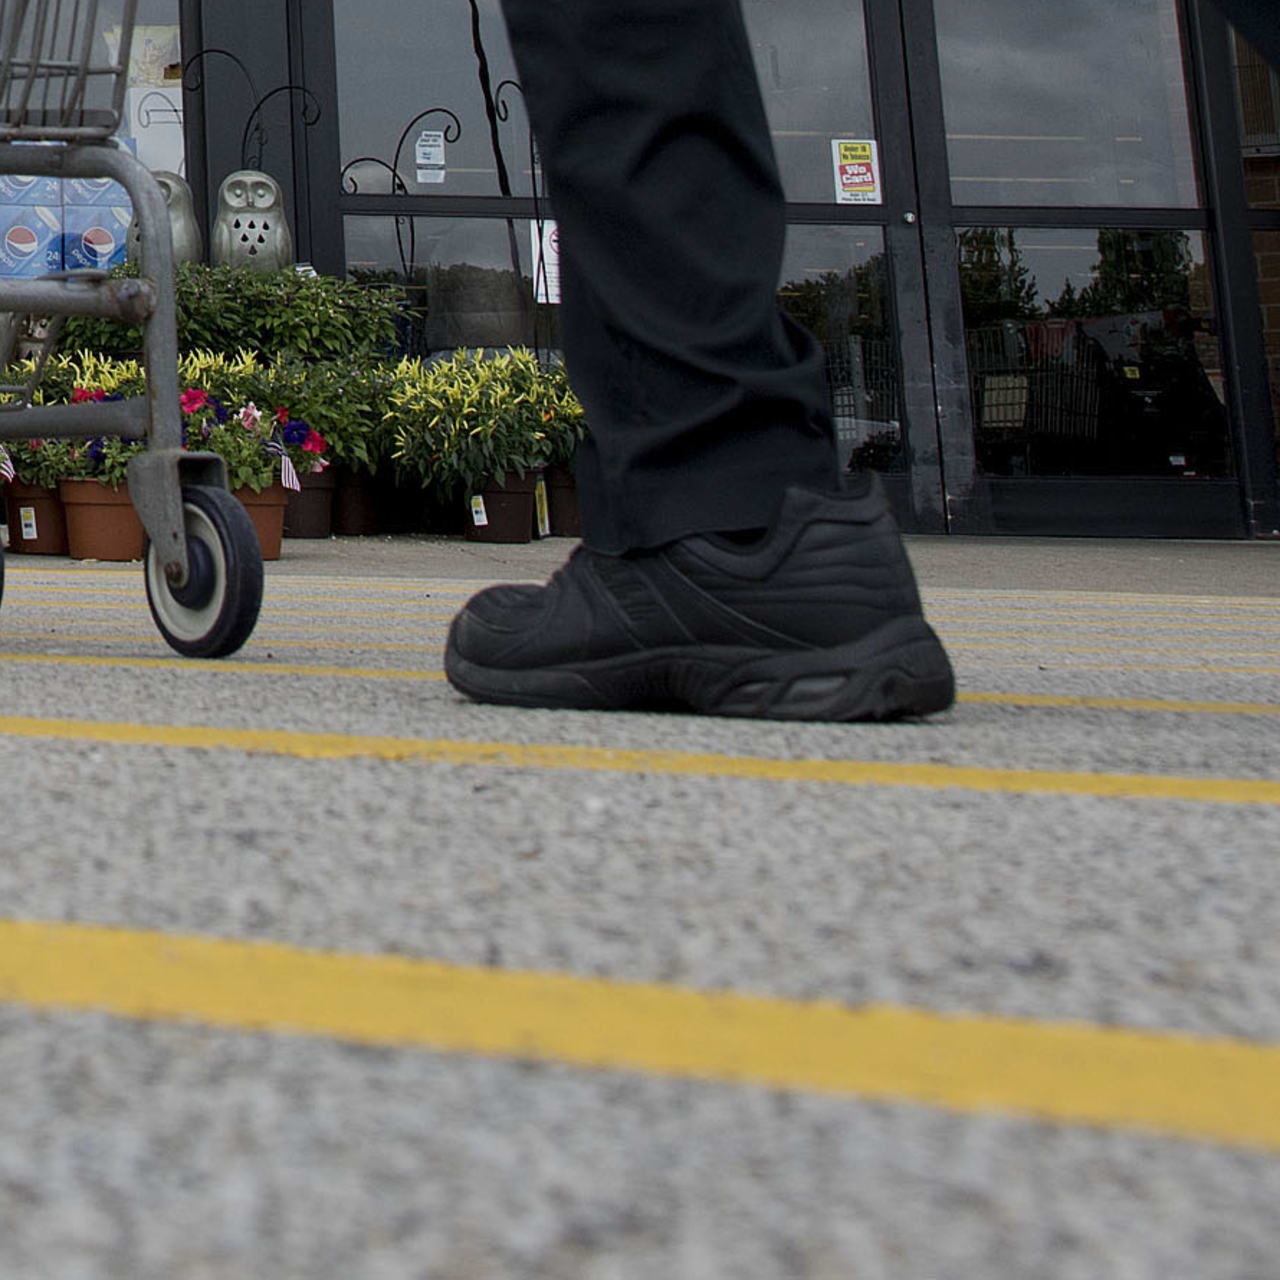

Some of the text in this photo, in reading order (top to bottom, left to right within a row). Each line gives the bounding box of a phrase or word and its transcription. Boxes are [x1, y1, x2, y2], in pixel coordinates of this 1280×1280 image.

[845, 165, 867, 175] We
[842, 172, 872, 184] Card
[46, 251, 60, 261] 24
